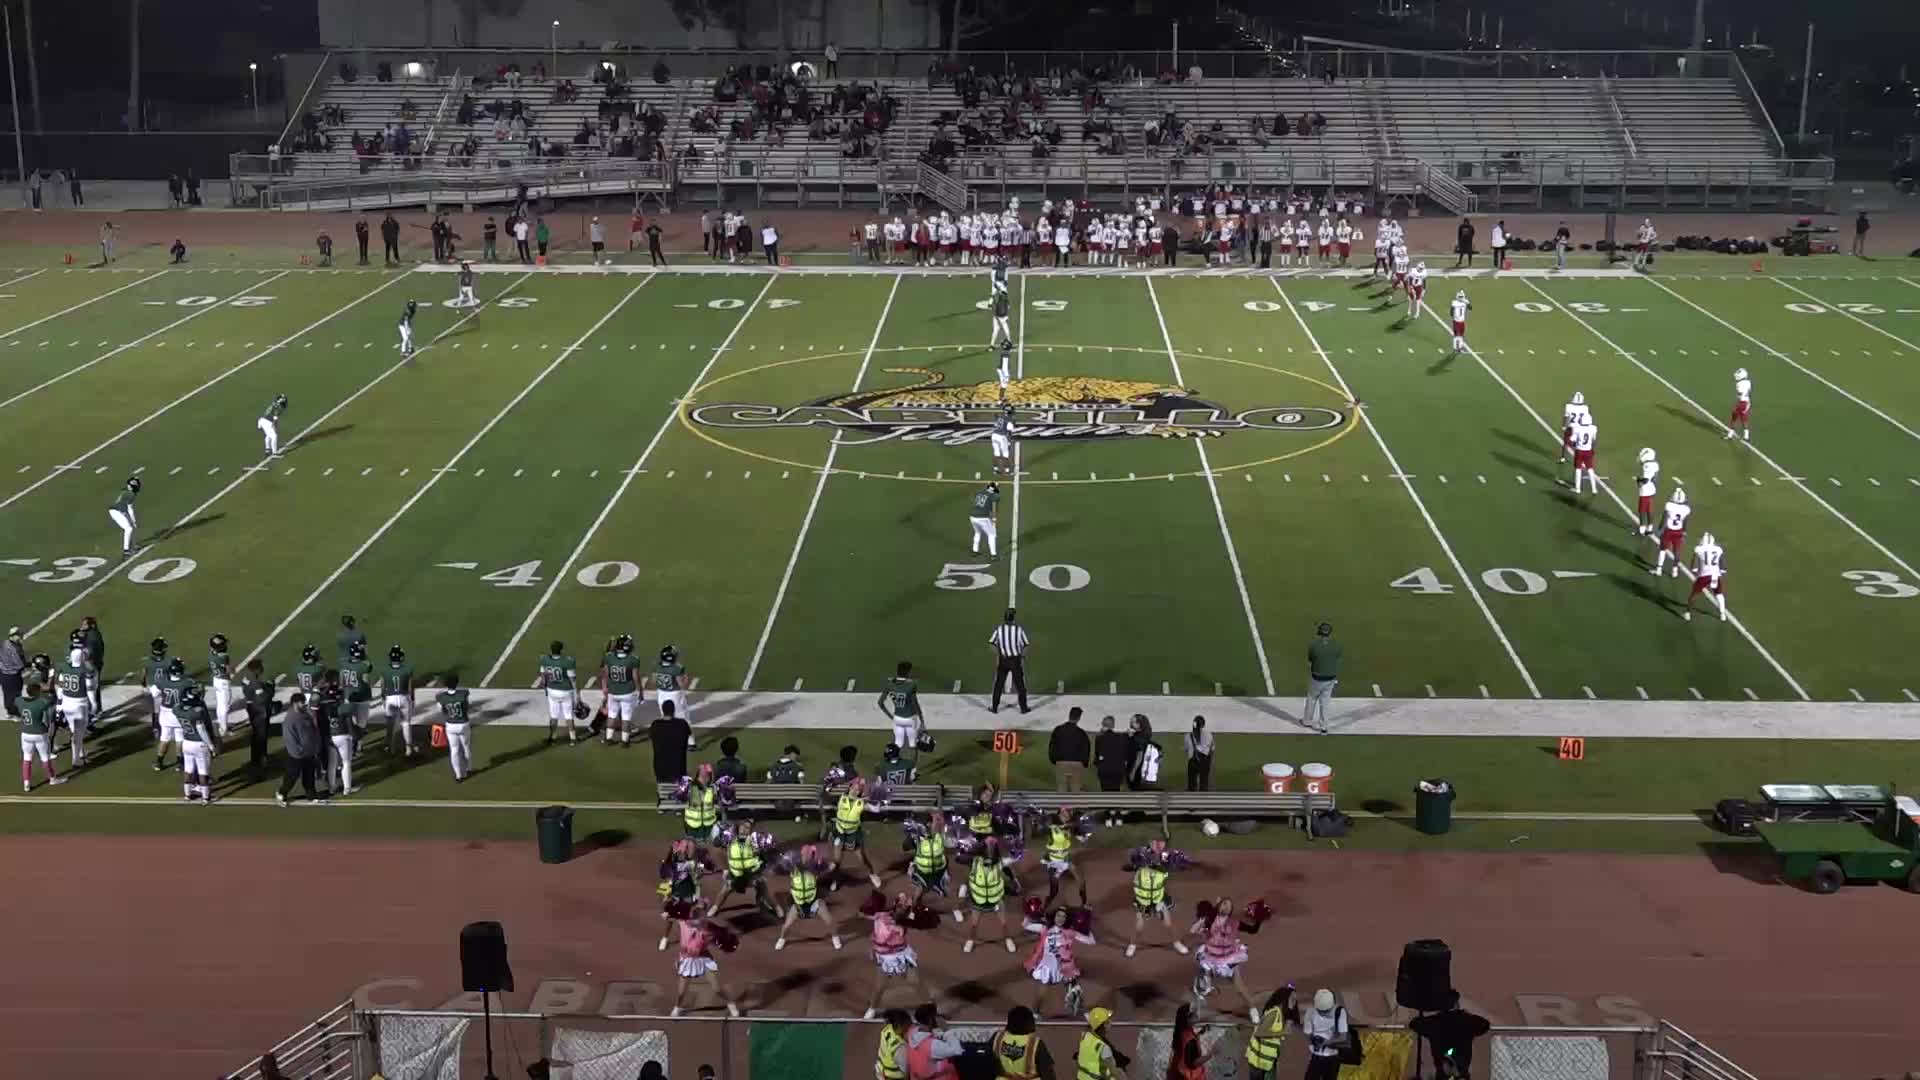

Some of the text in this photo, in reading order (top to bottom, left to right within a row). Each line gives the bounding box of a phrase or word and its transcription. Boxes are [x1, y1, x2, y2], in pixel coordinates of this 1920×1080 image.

[691, 404, 1344, 429] CABRILLO
[1704, 551, 1718, 566] 12
[28, 557, 197, 583] 30
[479, 560, 641, 587] 40
[934, 563, 1091, 590] 50
[1390, 567, 1548, 594] 40
[995, 732, 1013, 751] 50
[1561, 739, 1582, 759] 40
[1271, 782, 1284, 793] G
[1307, 782, 1320, 793] G
